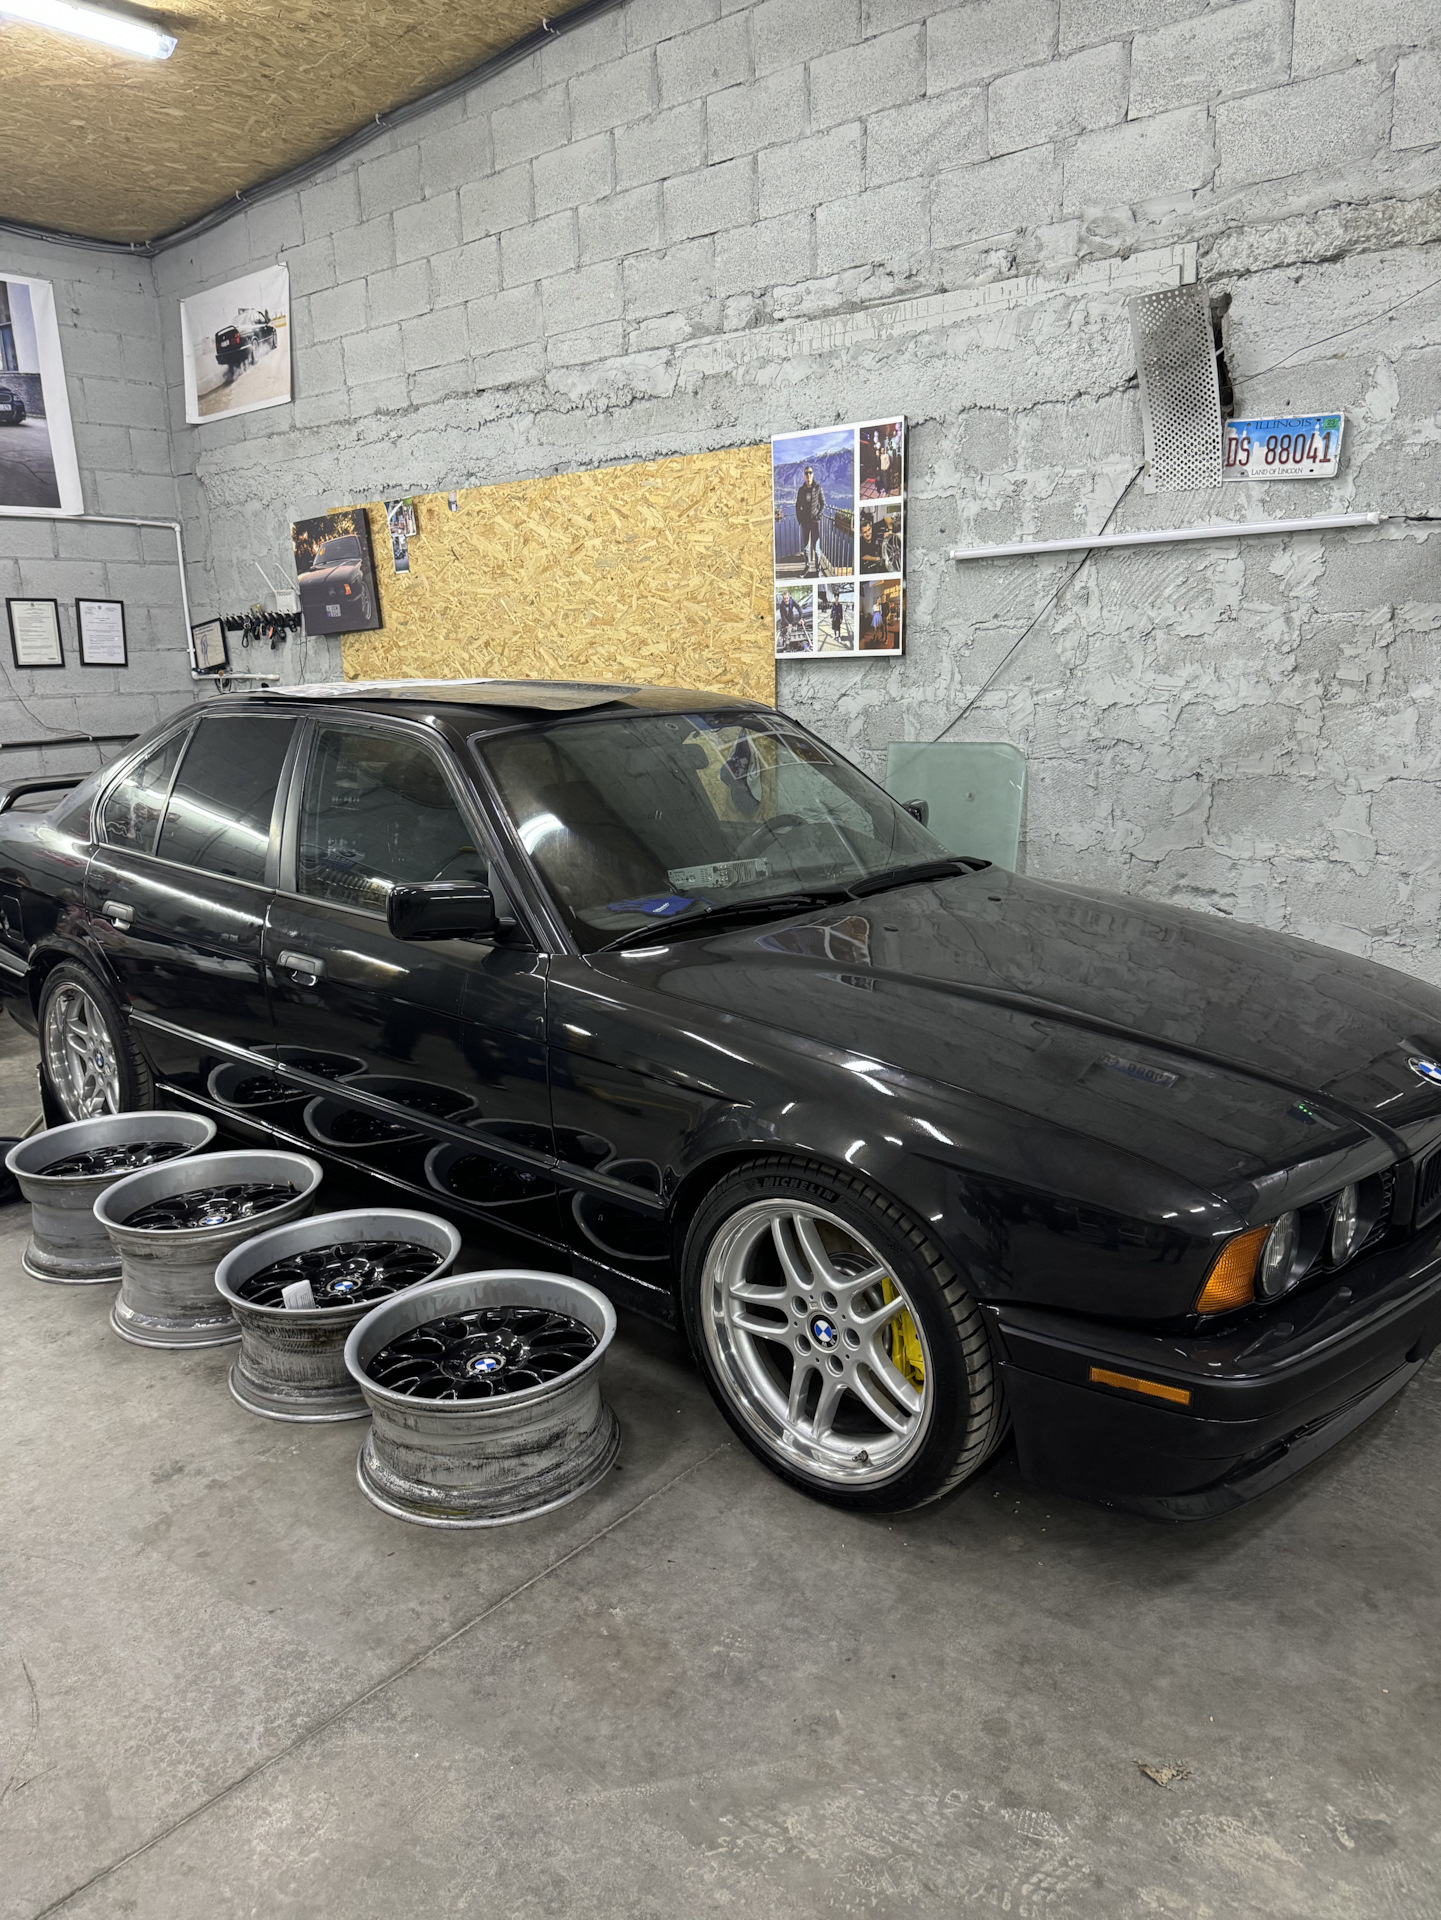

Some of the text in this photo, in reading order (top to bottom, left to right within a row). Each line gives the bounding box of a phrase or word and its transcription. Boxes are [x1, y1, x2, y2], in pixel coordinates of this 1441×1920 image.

[1256, 419, 1312, 430] ILLINOIS
[1225, 432, 1331, 467] DS 88041
[1251, 468, 1268, 476] LAND
[1277, 467, 1303, 475] LINCOLN
[763, 1176, 837, 1201] MICHELIN
[843, 1200, 864, 1215] PILOT
